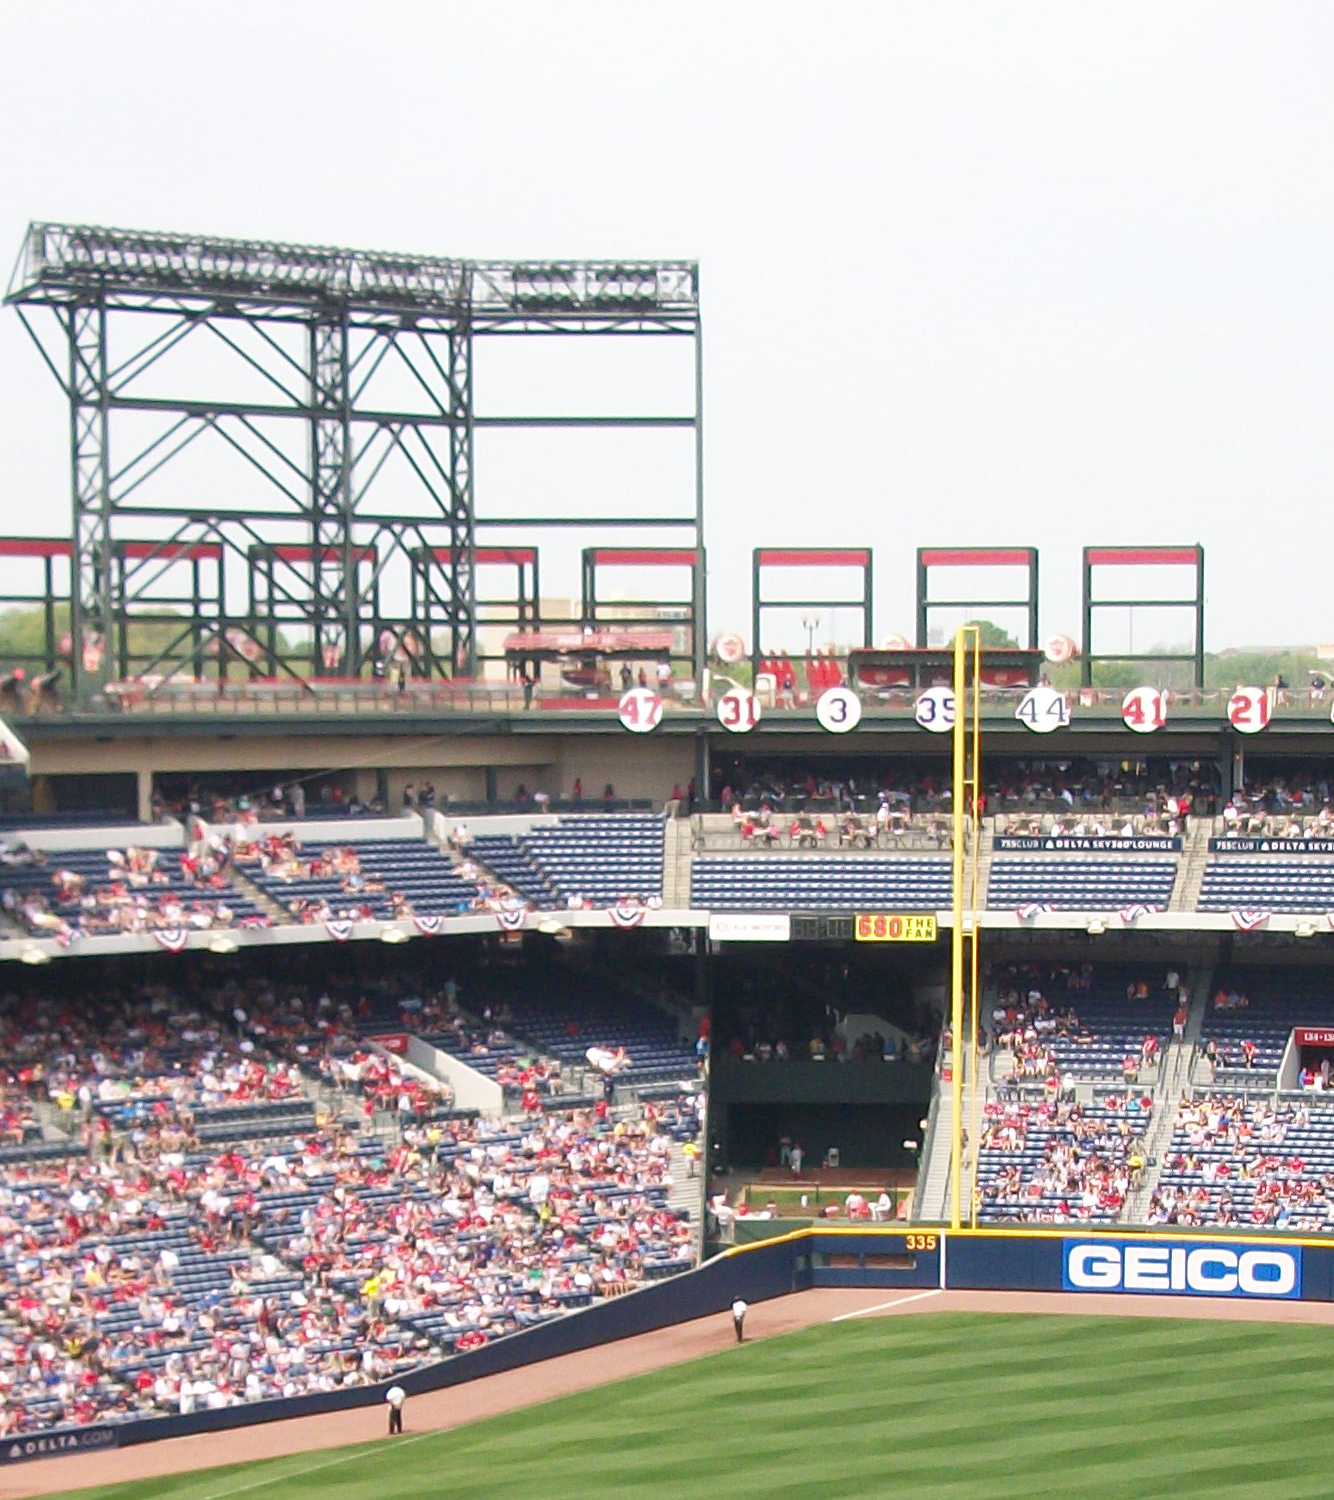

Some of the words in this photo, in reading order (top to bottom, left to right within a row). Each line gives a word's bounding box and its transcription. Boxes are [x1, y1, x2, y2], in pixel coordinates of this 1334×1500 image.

[619, 696, 663, 726] 47
[722, 696, 758, 726] 31
[830, 698, 847, 723] 3
[917, 697, 956, 724] 35
[1017, 697, 1067, 724] 44
[1122, 696, 1166, 727] 41
[1230, 695, 1268, 725] 21
[1056, 839, 1090, 848] DELTA
[1271, 842, 1305, 850] DELTA
[858, 914, 903, 938] 680
[906, 919, 933, 929] THE
[906, 929, 933, 939] FAN
[906, 1235, 937, 1250] 335
[1067, 1244, 1296, 1294] GEICO
